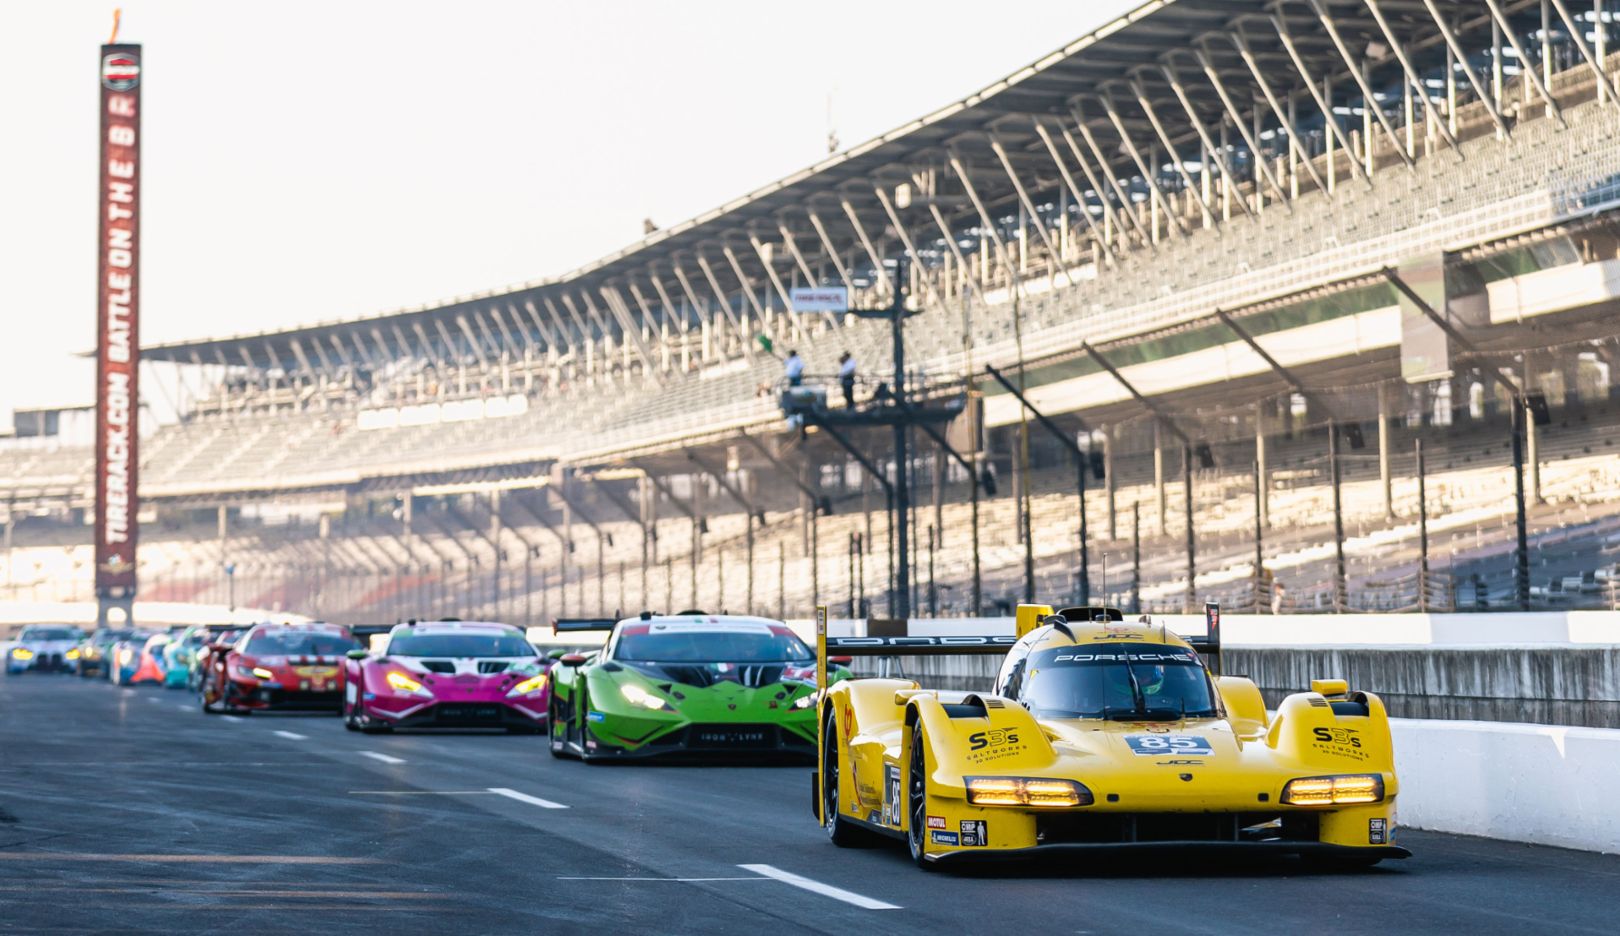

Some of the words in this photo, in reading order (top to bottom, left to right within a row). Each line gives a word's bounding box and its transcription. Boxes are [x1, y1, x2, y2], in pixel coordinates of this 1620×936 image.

[108, 159, 134, 221] THE
[108, 227, 133, 268] ON
[107, 271, 130, 363] BATTLE
[105, 372, 129, 545] TIRERACK.COM
[1054, 653, 1193, 663] PORSCHE
[1138, 736, 1198, 749] 85
[927, 817, 946, 828] MOTUL
